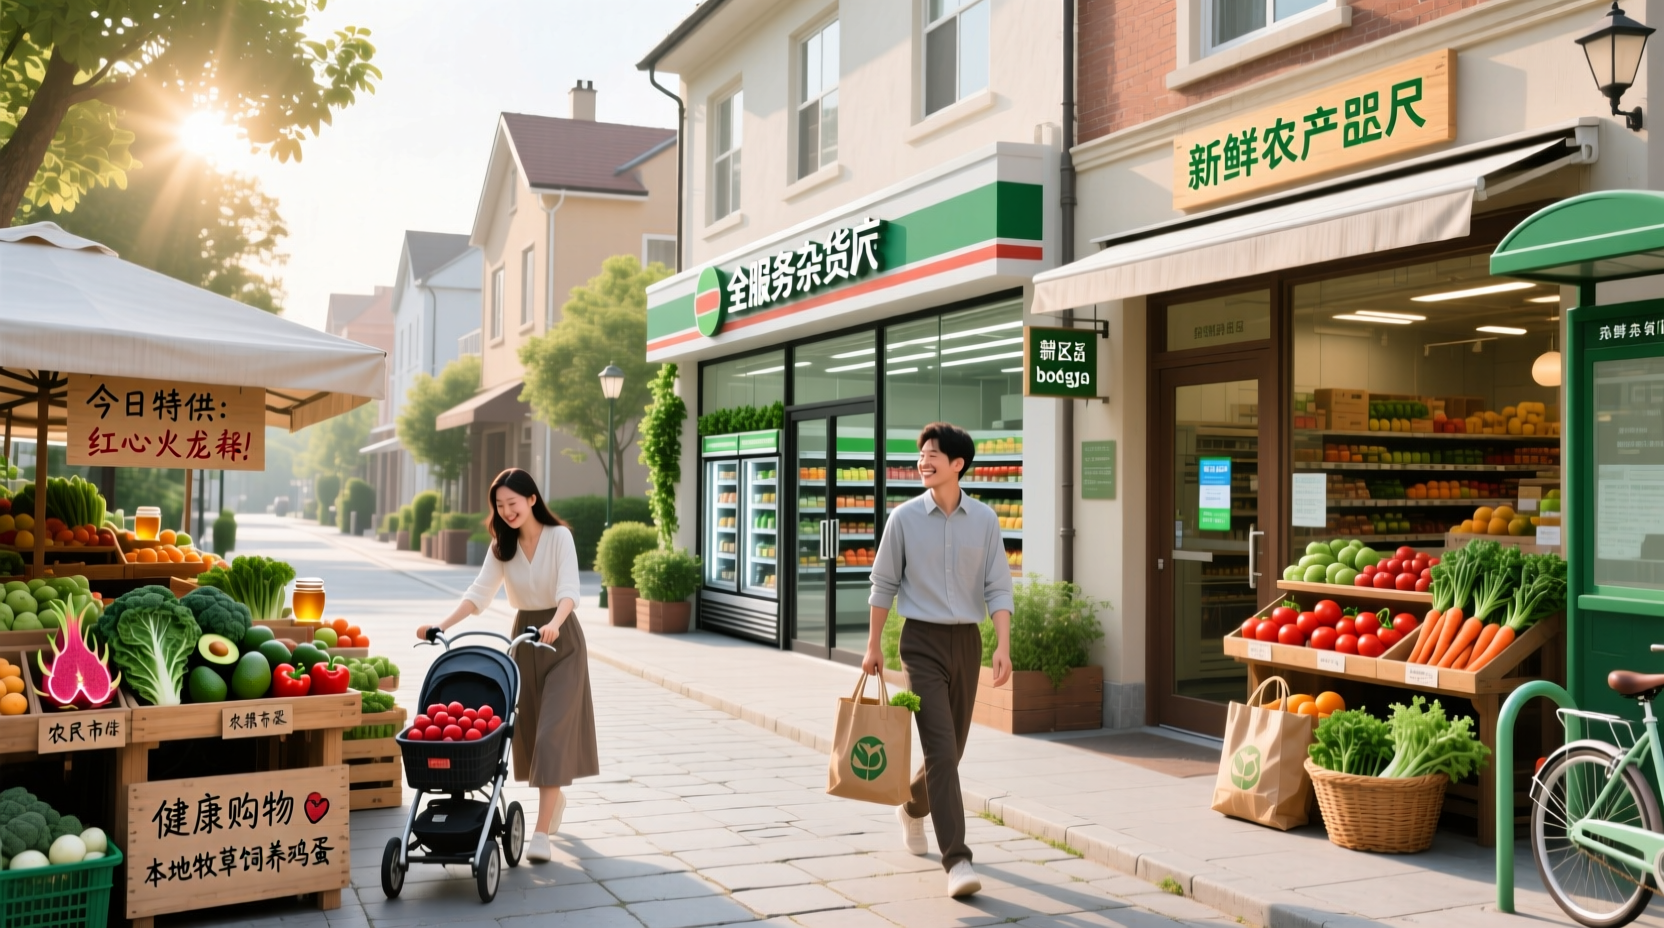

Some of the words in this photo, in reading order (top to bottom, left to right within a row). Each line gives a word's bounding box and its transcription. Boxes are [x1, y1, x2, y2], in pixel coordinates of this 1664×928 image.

[152, 790, 294, 839] 健康购物
[144, 836, 335, 888] 本地牧草饲养鸡蛋
